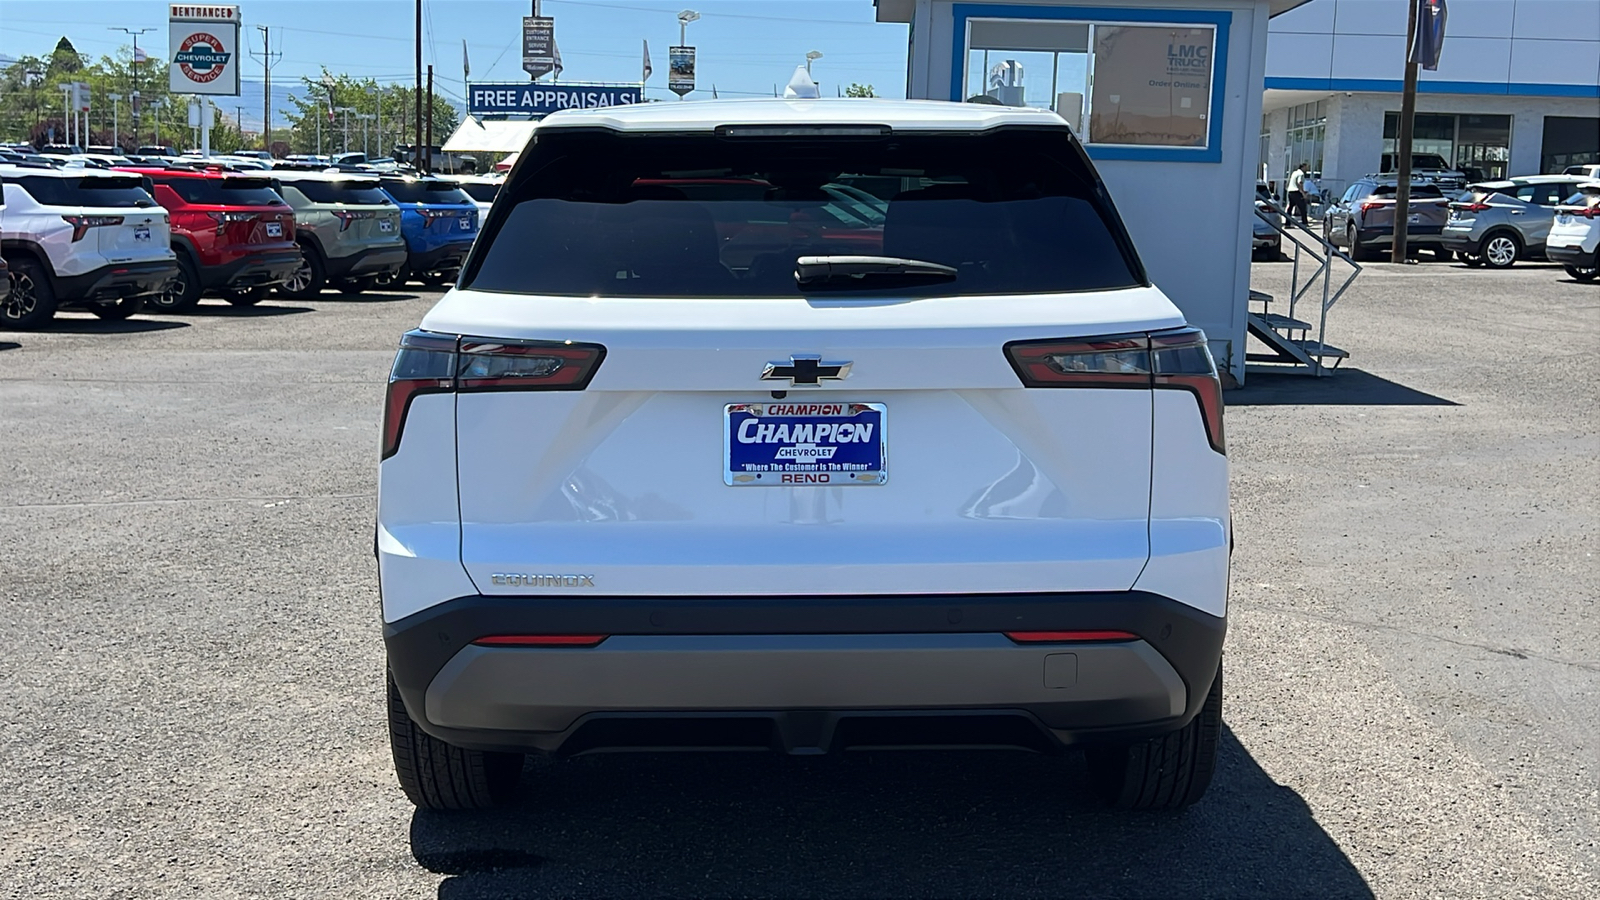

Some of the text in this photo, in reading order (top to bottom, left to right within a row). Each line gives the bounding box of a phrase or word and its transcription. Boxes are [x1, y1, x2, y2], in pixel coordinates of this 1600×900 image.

[179, 7, 226, 18] ENTRANCE
[185, 34, 218, 47] SUPER
[1167, 44, 1208, 58] LMC
[177, 54, 227, 62] CHEVROLET
[1167, 57, 1206, 67] TRUCK
[183, 66, 222, 82] SERVICE
[474, 90, 517, 107] FREE
[767, 405, 843, 415] CHAMPION
[737, 418, 874, 444] CHAMPION
[779, 449, 833, 457] CHEVROLET
[741, 463, 873, 471] "Where The Customer Is The Winner"
[781, 474, 831, 483] RENO
[491, 572, 595, 588] EQUINOX
